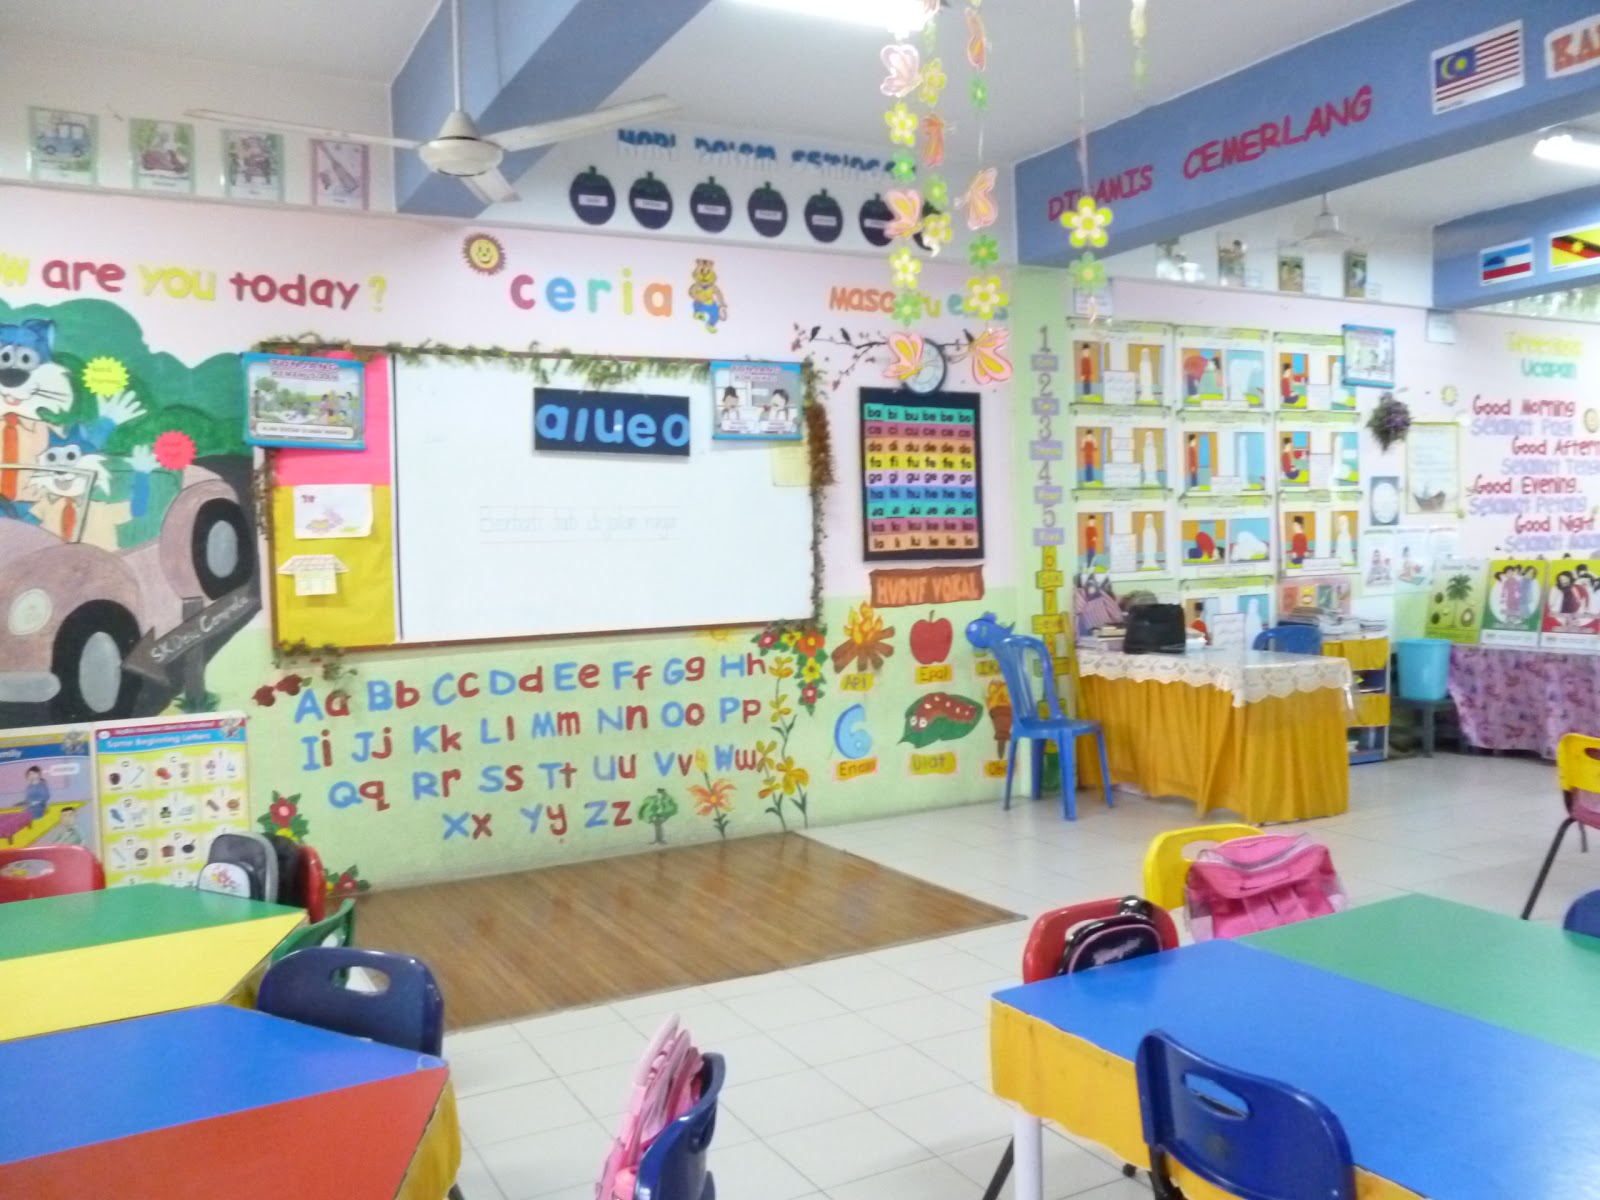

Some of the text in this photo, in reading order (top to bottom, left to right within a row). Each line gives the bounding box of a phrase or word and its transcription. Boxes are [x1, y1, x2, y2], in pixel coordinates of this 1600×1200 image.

[1048, 85, 1373, 221] DIAMIS CEMERLANG
[43, 259, 125, 292] are
[136, 264, 217, 301] you
[510, 267, 673, 317] ceria
[1039, 325, 1051, 353] 1
[1039, 373, 1053, 397] 2
[1473, 394, 1511, 416] Good
[1039, 415, 1052, 441] 3
[1512, 436, 1547, 455] Good
[1038, 460, 1052, 485] 4
[1474, 474, 1512, 494] Good
[1042, 503, 1057, 528] 5
[1515, 514, 1551, 533] Good
[920, 667, 949, 682] Epal
[294, 652, 766, 724] Aa Bb Cc Dd Ee Ff Gg Hh
[350, 726, 393, 763] Jj
[412, 724, 462, 754] Kk
[531, 709, 581, 737] Mm
[598, 702, 649, 733] Nn
[661, 701, 705, 728] Oo
[719, 697, 761, 724] Pp
[328, 744, 758, 811] Qq Rr Ss Tt Uu Vv Ww
[441, 800, 632, 840] Xx Yy Zz
